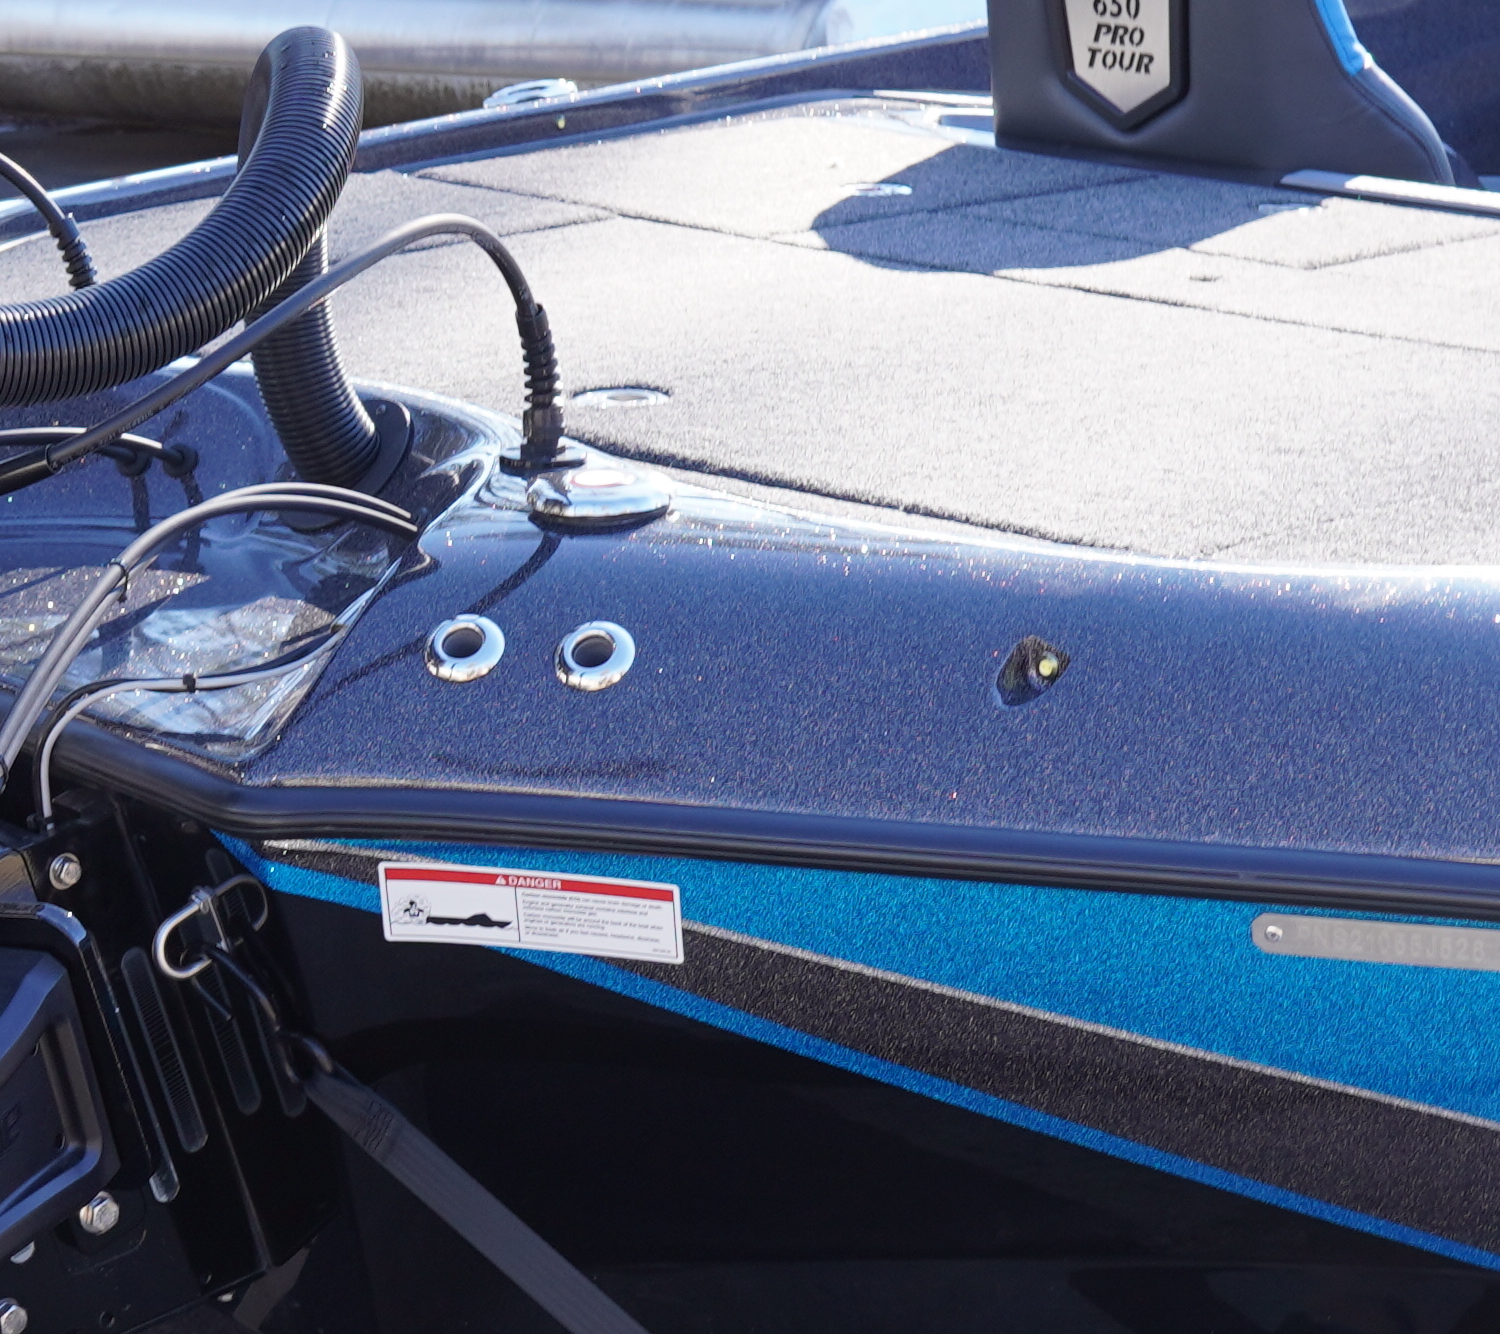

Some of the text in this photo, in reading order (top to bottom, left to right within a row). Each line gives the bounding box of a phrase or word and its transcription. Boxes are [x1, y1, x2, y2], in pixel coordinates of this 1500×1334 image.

[1093, 23, 1145, 47] PRO
[1088, 47, 1154, 74] TOUR
[509, 875, 562, 890] DANGER
